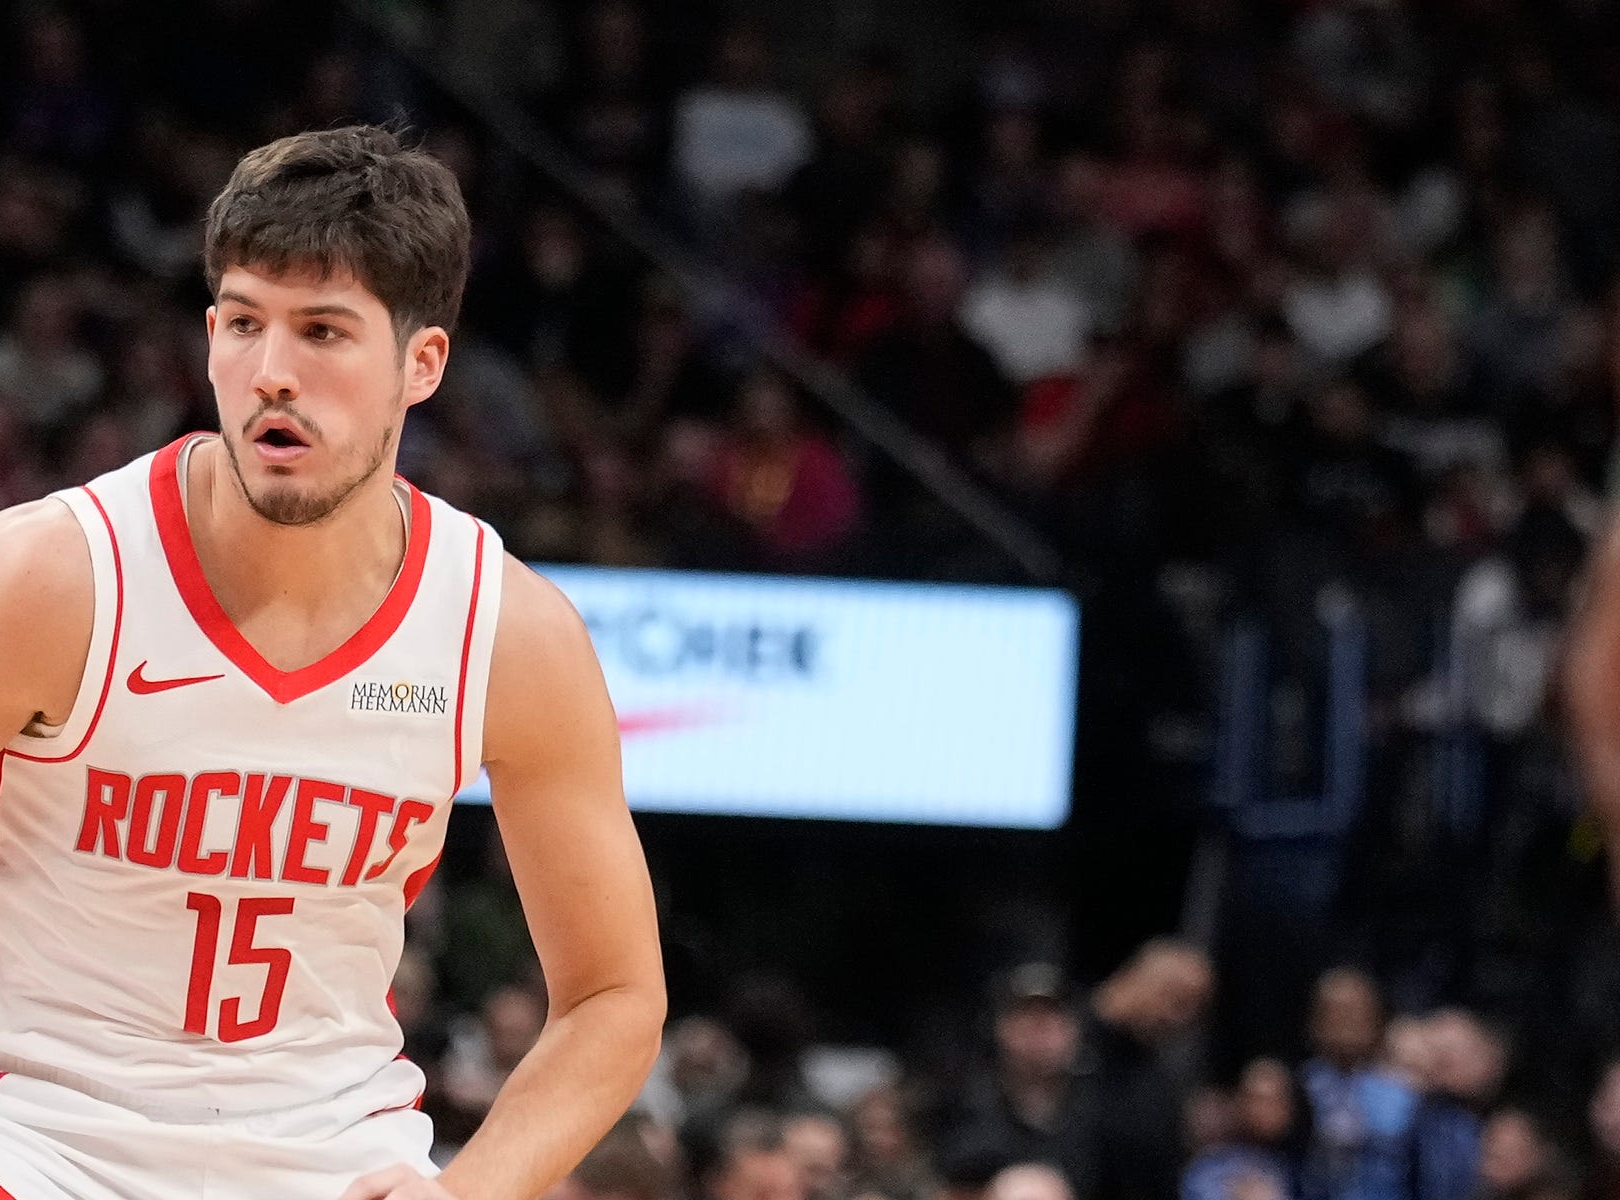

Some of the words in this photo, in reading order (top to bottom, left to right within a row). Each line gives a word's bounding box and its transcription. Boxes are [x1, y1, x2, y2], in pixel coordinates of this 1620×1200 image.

[351, 696, 447, 714] HERMANN
[353, 682, 448, 702] MEMORIAL
[74, 765, 434, 888] ROCKETS
[182, 891, 295, 1043] 15
